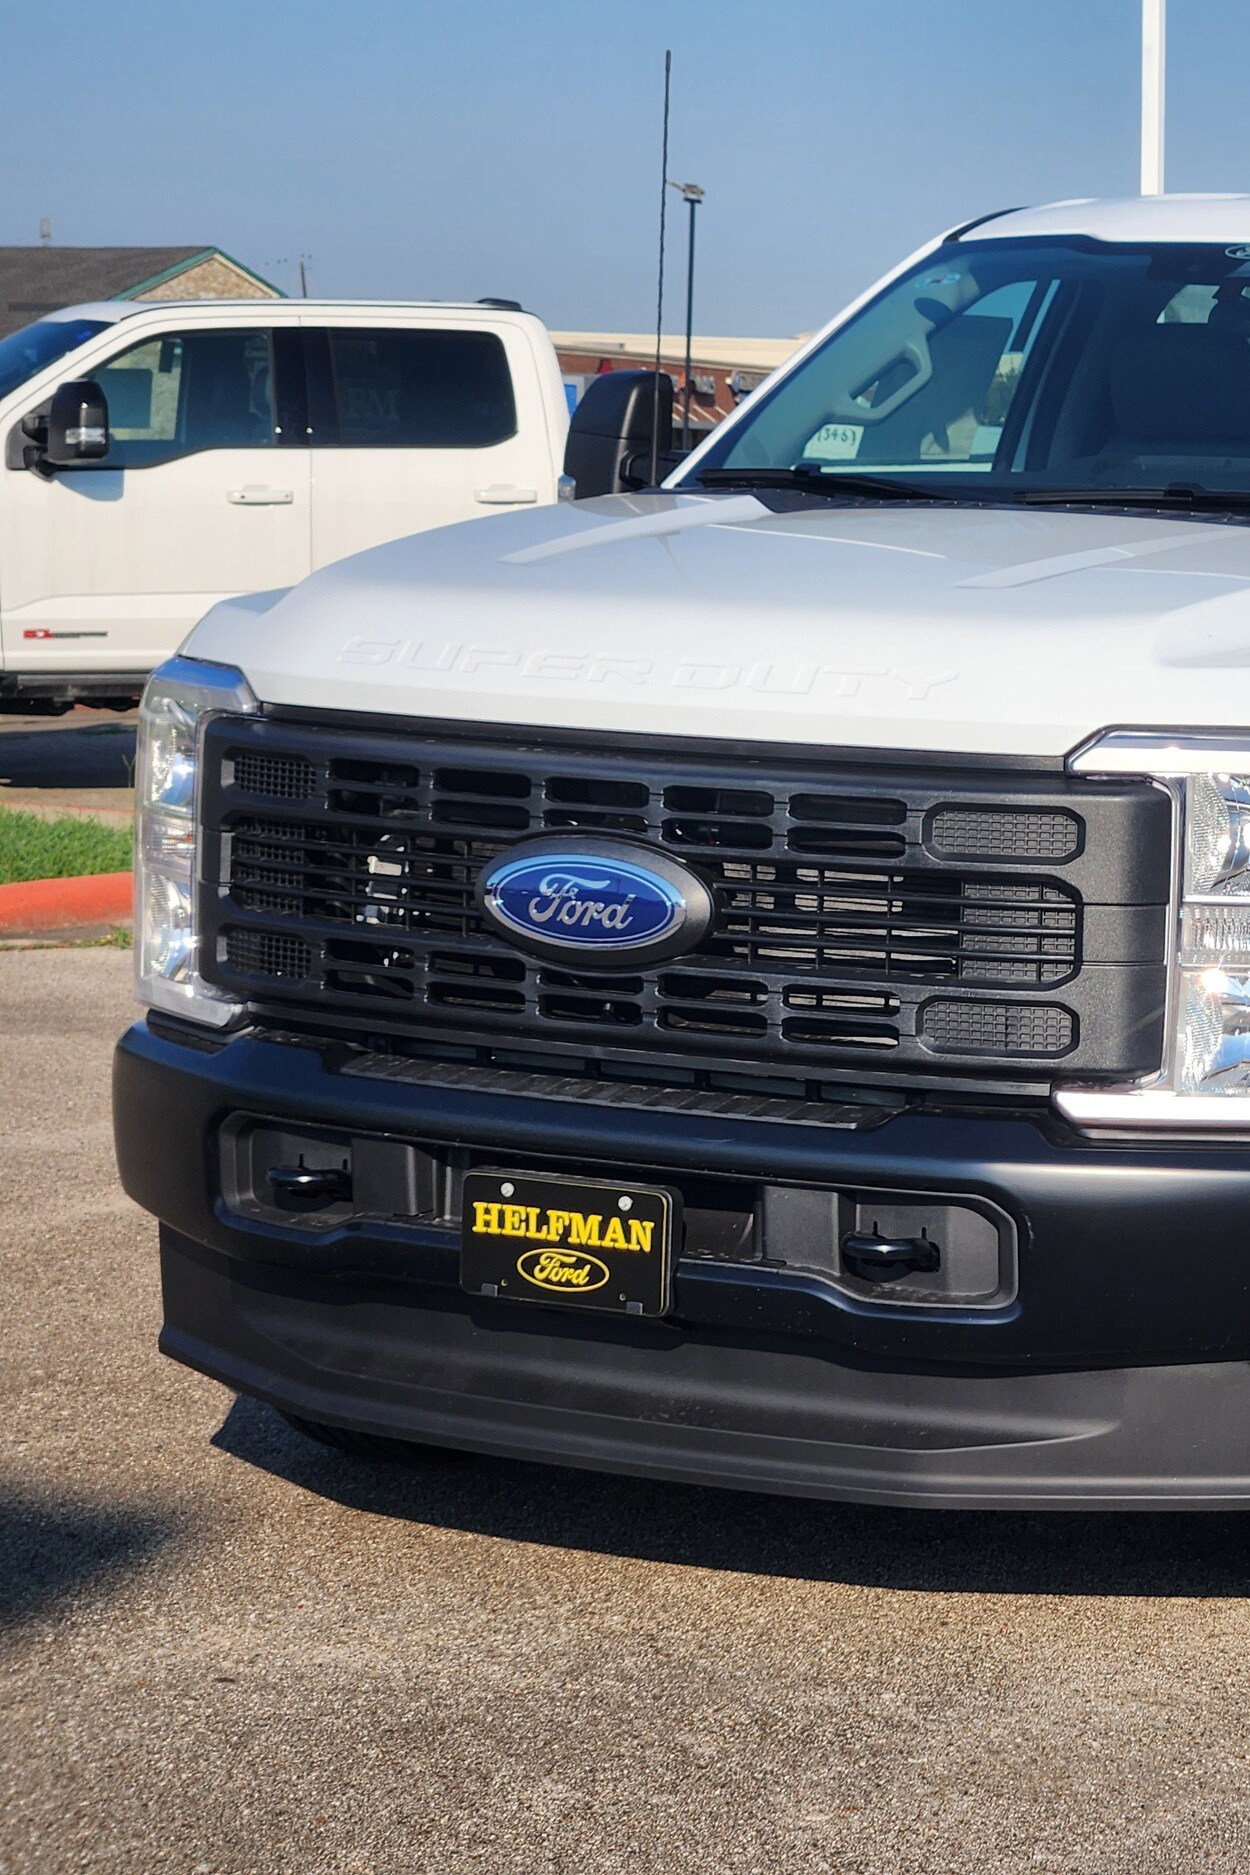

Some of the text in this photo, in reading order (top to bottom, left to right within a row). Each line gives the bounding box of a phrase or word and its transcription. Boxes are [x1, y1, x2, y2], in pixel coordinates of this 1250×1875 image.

[336, 634, 960, 701] SUPER DUTY
[528, 873, 637, 930] Ford
[472, 1201, 655, 1253] HELFMAN
[533, 1252, 592, 1285] Ford
